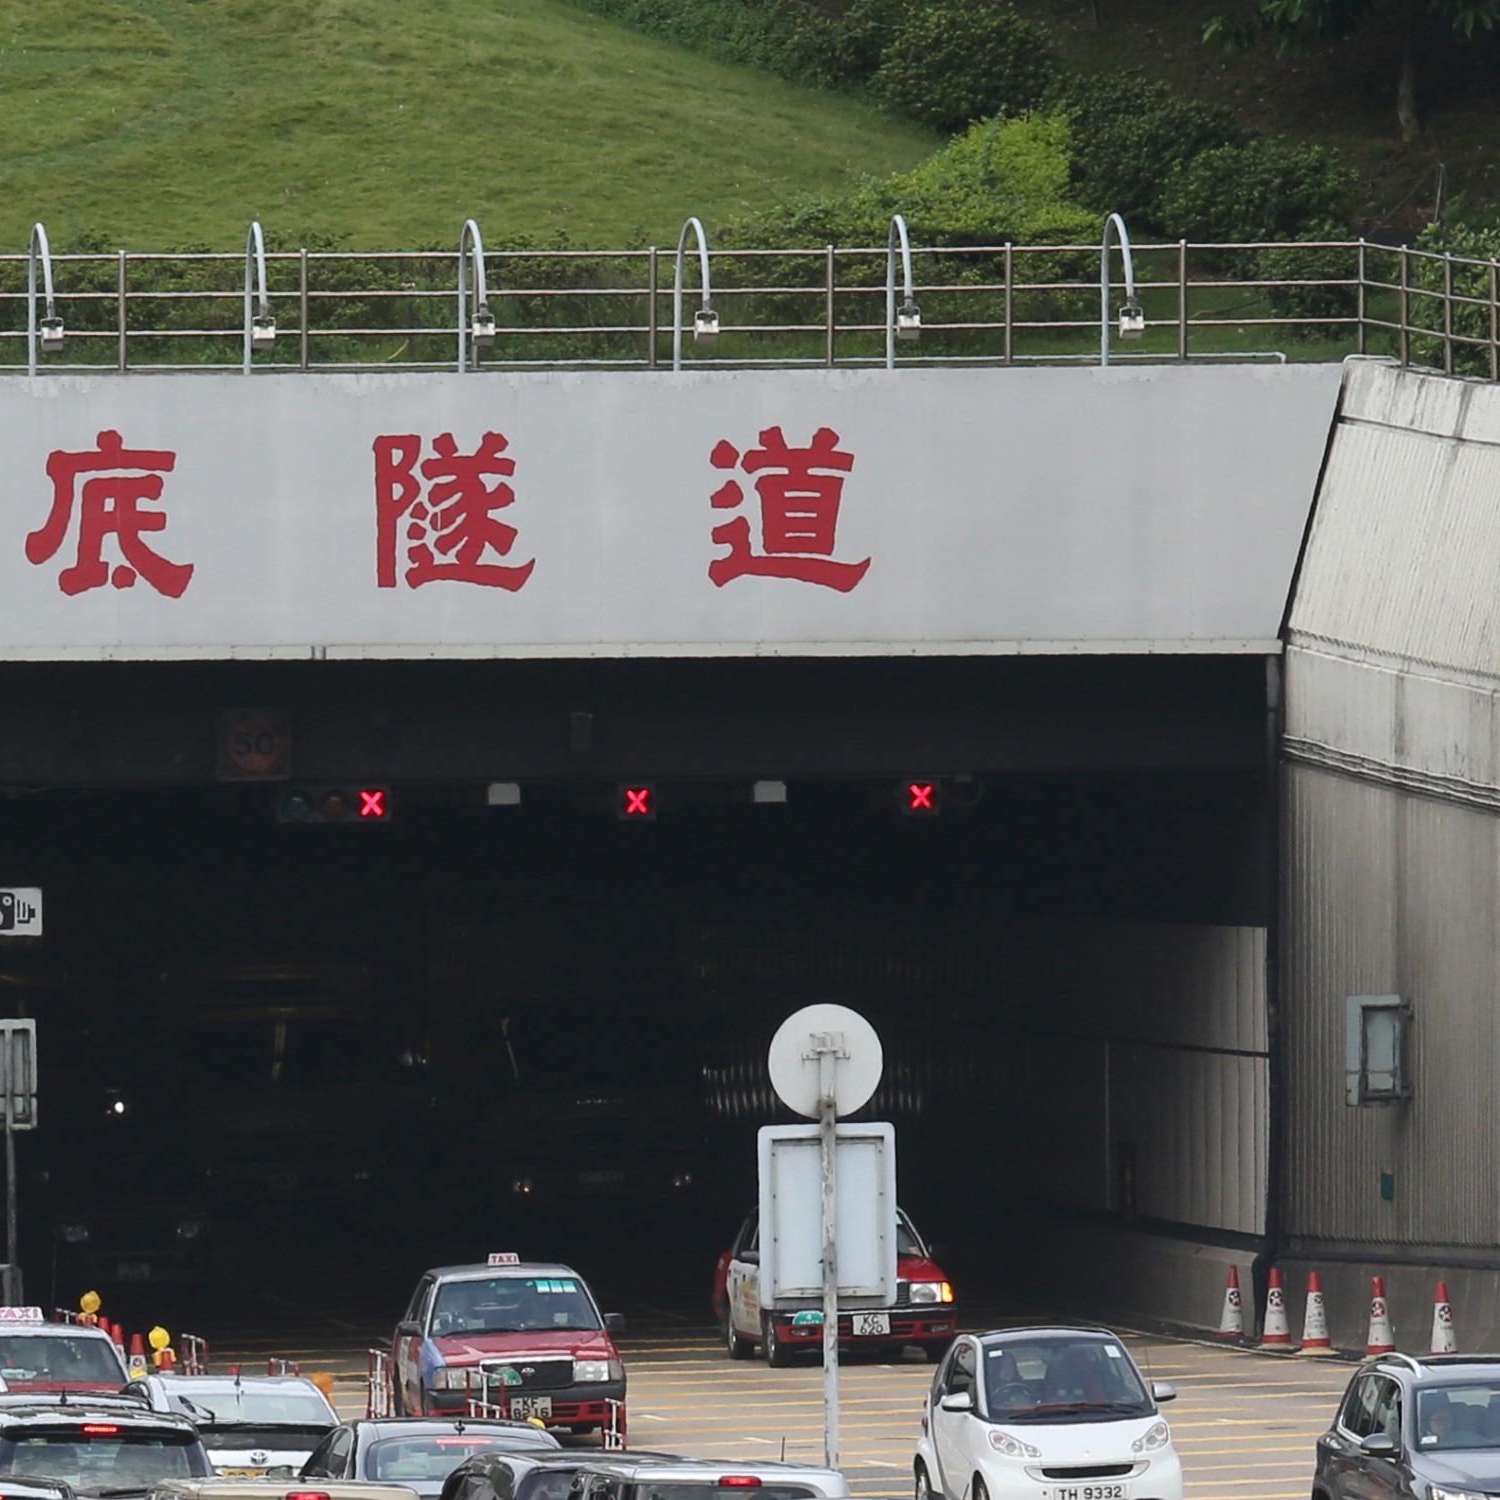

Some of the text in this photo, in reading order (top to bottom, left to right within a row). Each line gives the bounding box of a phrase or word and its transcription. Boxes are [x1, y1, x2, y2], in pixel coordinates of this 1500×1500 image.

[491, 1255, 517, 1264] TAXI
[863, 1314, 879, 1325] KC
[860, 1324, 884, 1334] 620
[1059, 1485, 1122, 1500] TH 9332
